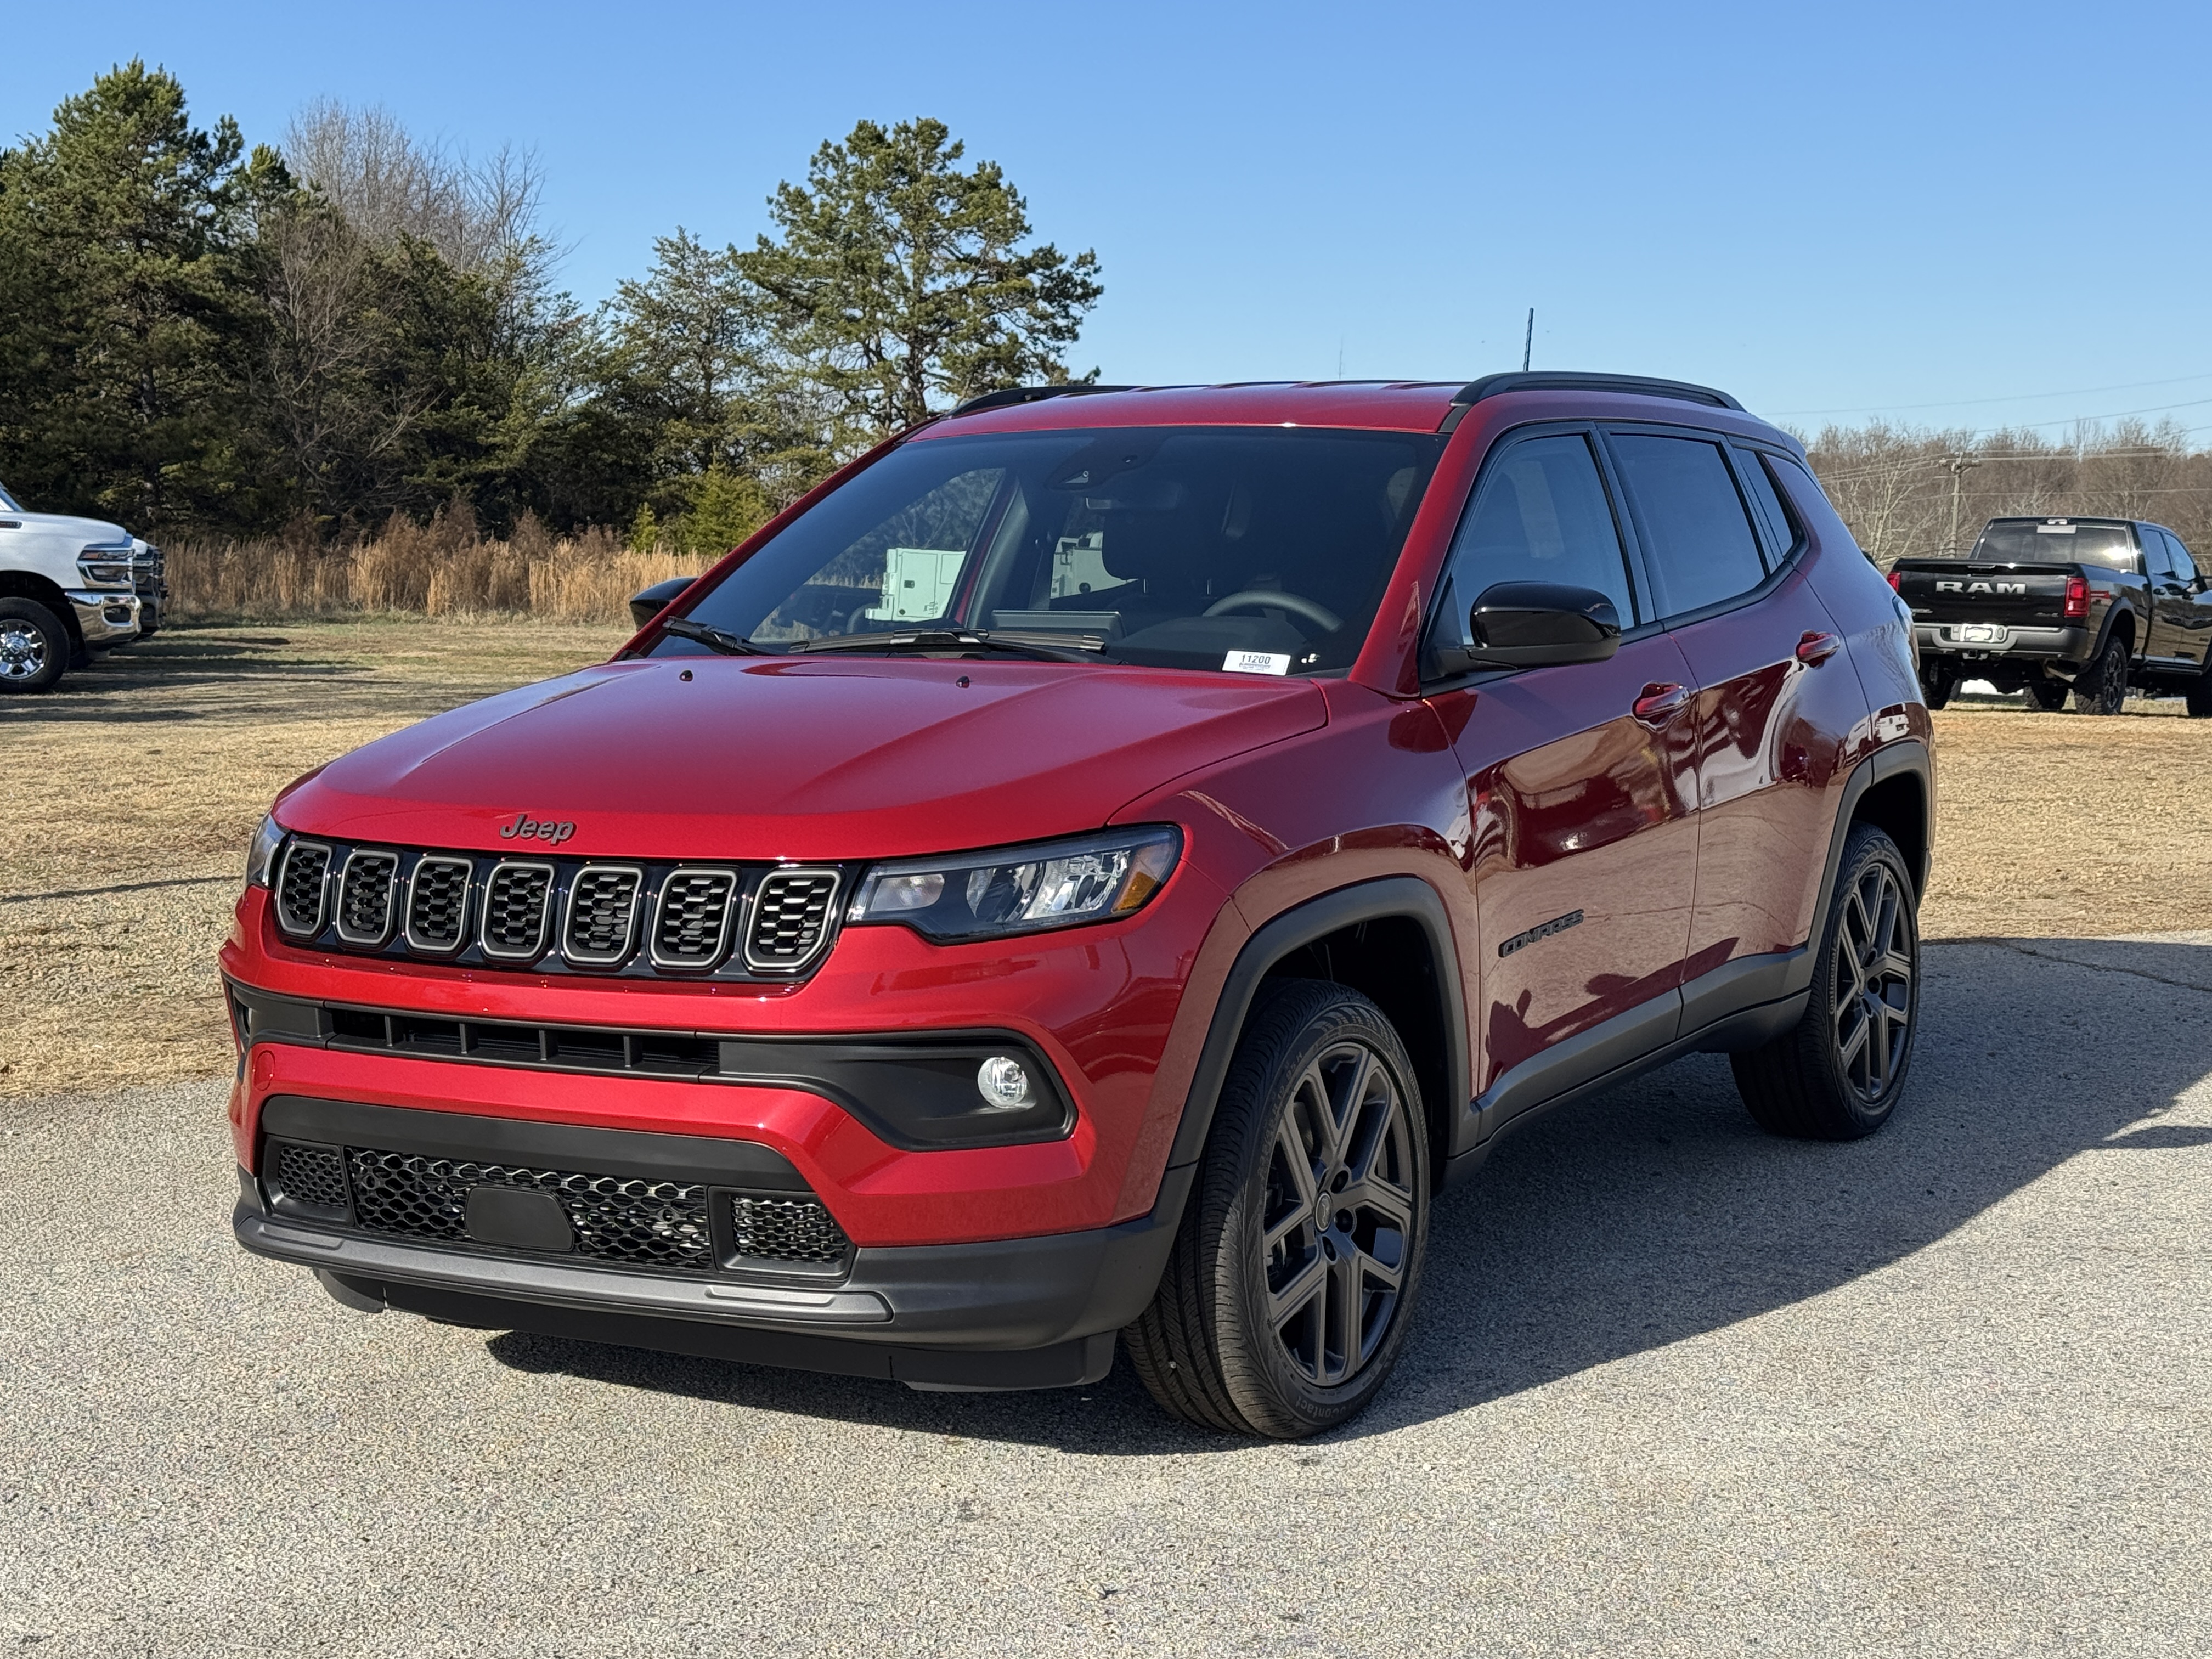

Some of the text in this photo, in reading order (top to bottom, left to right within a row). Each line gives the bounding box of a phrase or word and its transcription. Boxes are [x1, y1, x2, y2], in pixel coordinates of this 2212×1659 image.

[1936, 581, 2025, 594] RAM
[1242, 654, 1271, 664] 11200
[500, 814, 576, 846] Jeep
[1498, 909, 1584, 957] COMPASS
